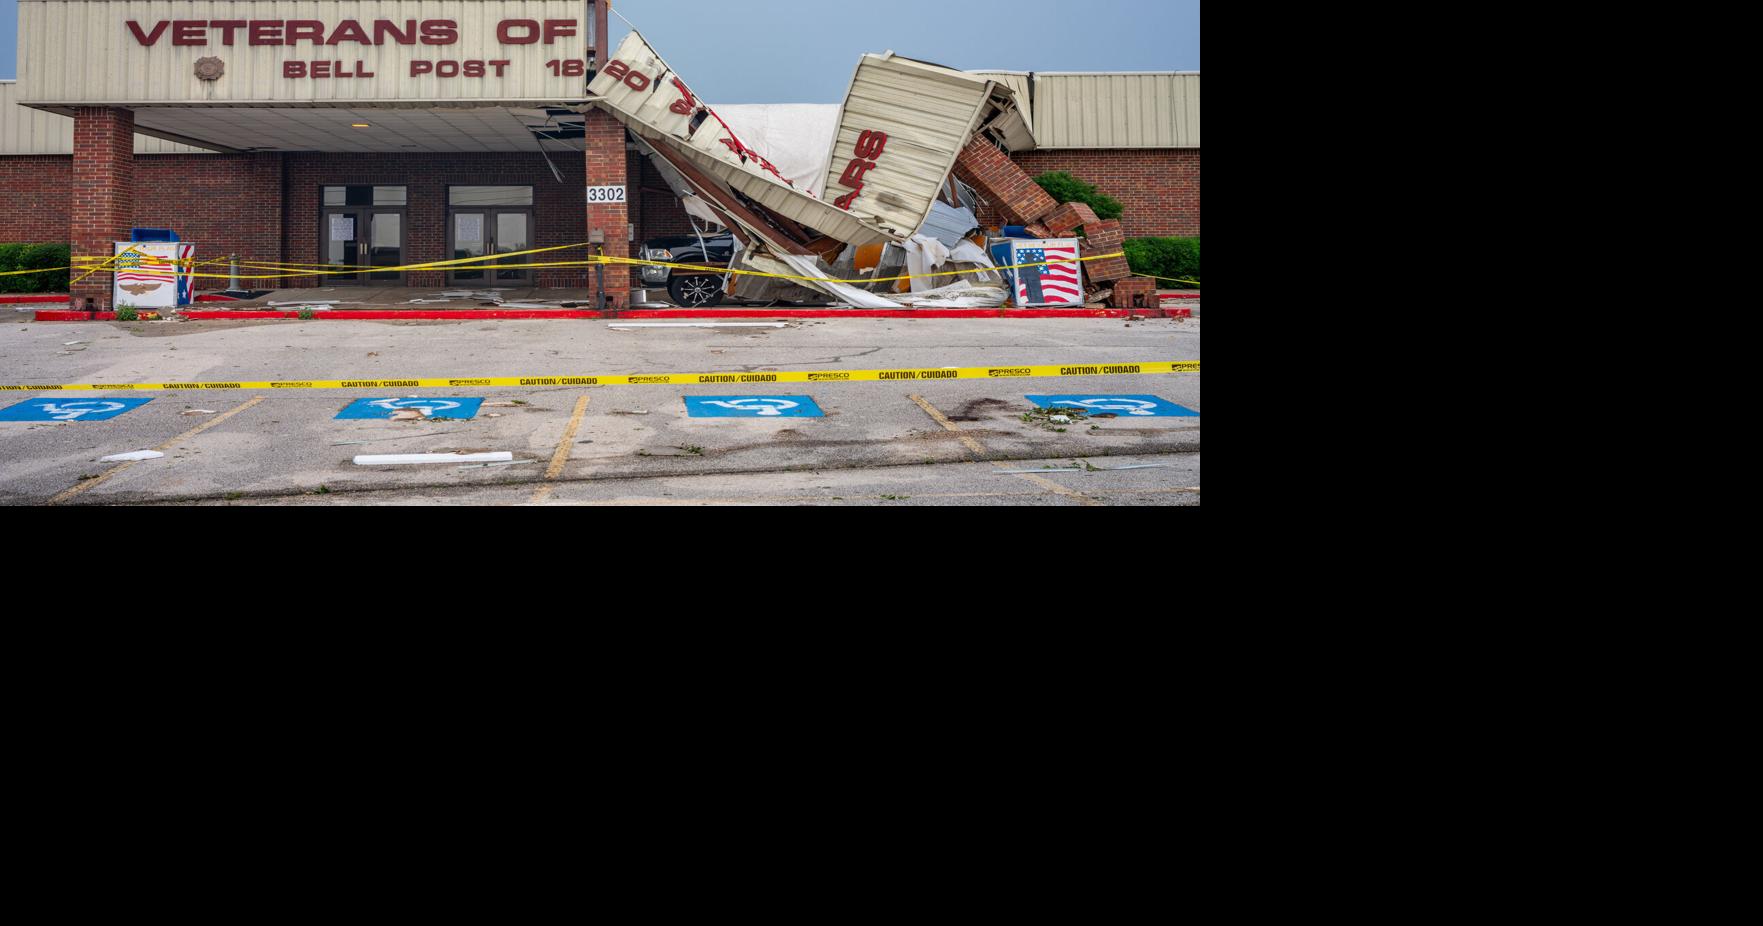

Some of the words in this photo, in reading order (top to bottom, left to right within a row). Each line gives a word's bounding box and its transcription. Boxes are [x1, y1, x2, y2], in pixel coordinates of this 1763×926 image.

[125, 19, 458, 47] VETERANS
[496, 19, 578, 45] OF
[283, 60, 375, 79] BELL
[410, 60, 510, 78] POST
[545, 59, 585, 77] 18
[604, 59, 650, 92] 20
[589, 187, 624, 201] 3302
